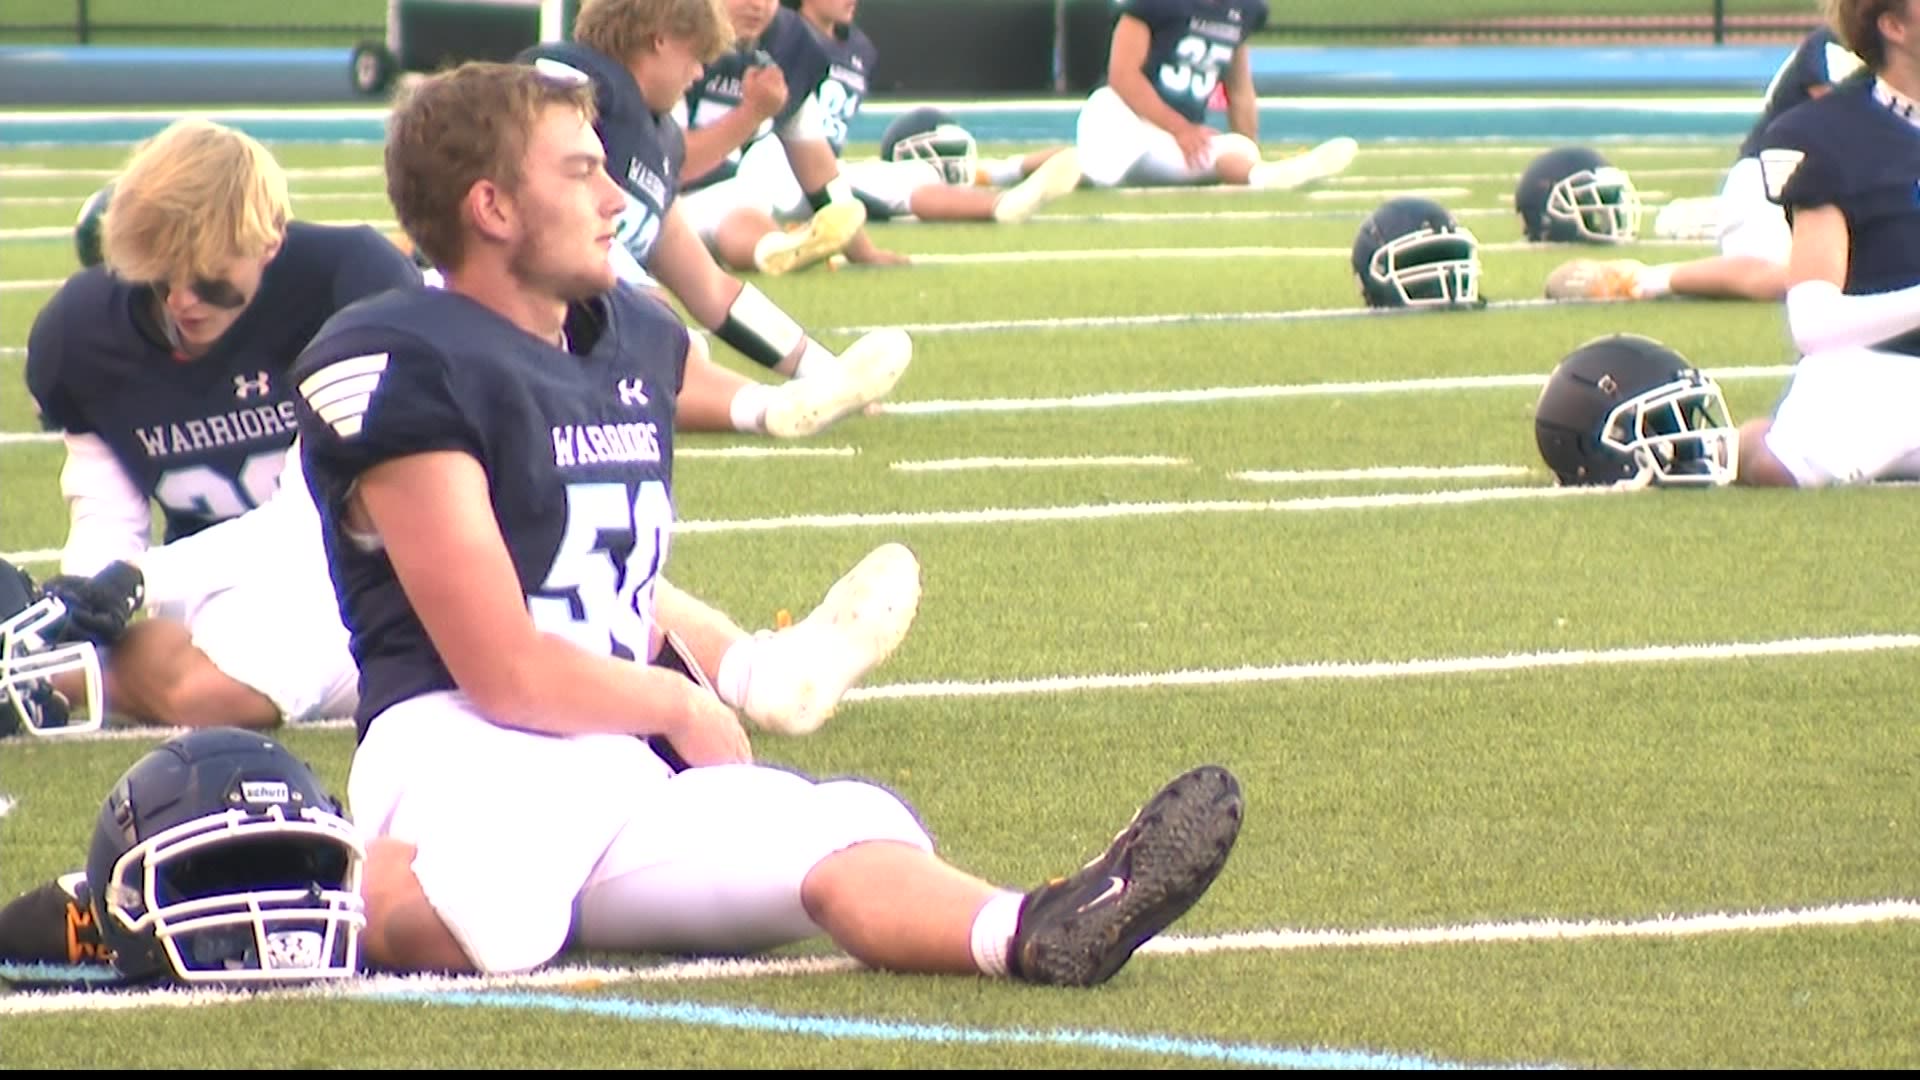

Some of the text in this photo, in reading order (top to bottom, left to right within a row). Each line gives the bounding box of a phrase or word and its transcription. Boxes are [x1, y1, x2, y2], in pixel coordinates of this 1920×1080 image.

[1159, 36, 1234, 100] 35
[134, 401, 299, 457] WARRIORS
[551, 422, 661, 467] WARRIORS
[527, 480, 671, 667] 50
